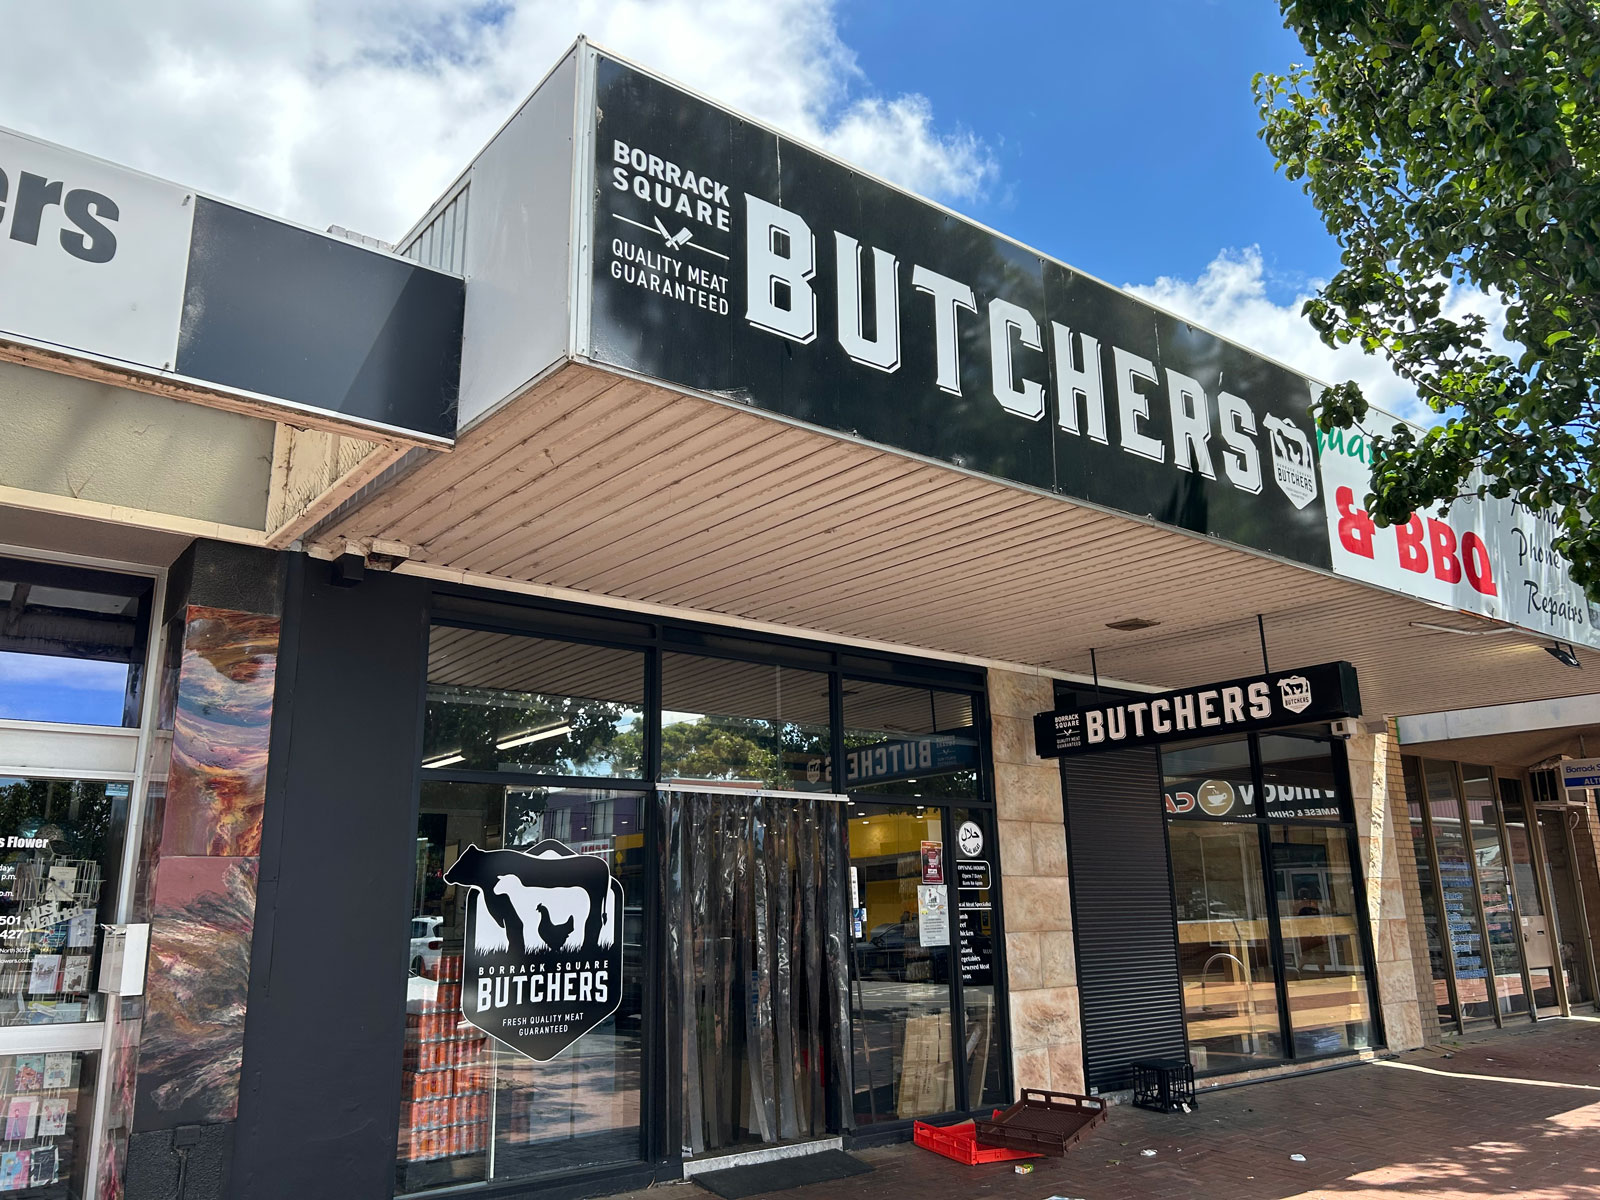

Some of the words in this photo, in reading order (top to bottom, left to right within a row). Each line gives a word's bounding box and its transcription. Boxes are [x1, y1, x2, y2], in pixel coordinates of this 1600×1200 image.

[613, 139, 730, 208] BORRACK
[0, 168, 119, 263] rs
[612, 166, 730, 232] SQUARE
[612, 238, 682, 278] QUALITY
[687, 264, 729, 294] MEAT
[611, 260, 729, 316] GUARANTEED
[744, 192, 1263, 495] BUTCHERS
[1277, 467, 1313, 493] BUTCHERS
[1335, 485, 1376, 560] &
[1395, 511, 1498, 597] BBQ
[1510, 527, 1561, 570] Phone
[1523, 580, 1584, 626] Repairs
[1055, 714, 1079, 722] BORRACK
[1085, 681, 1272, 745] BUTCHERS
[1284, 696, 1310, 706] BUTCHERS
[1055, 720, 1080, 729] SQUARE
[1565, 764, 1596, 774] Borrack
[7, 836, 49, 849] Flower
[961, 827, 980, 842] حلال
[0, 929, 24, 940] 427
[478, 963, 546, 976] BORRACK
[556, 959, 609, 971] SQUARE
[476, 970, 609, 1013] BUTCHERS
[502, 1017, 528, 1027] FRESH
[530, 1014, 563, 1025] QUALITY
[564, 1012, 584, 1021] MEAT
[518, 1024, 569, 1036] GUARANTEED
